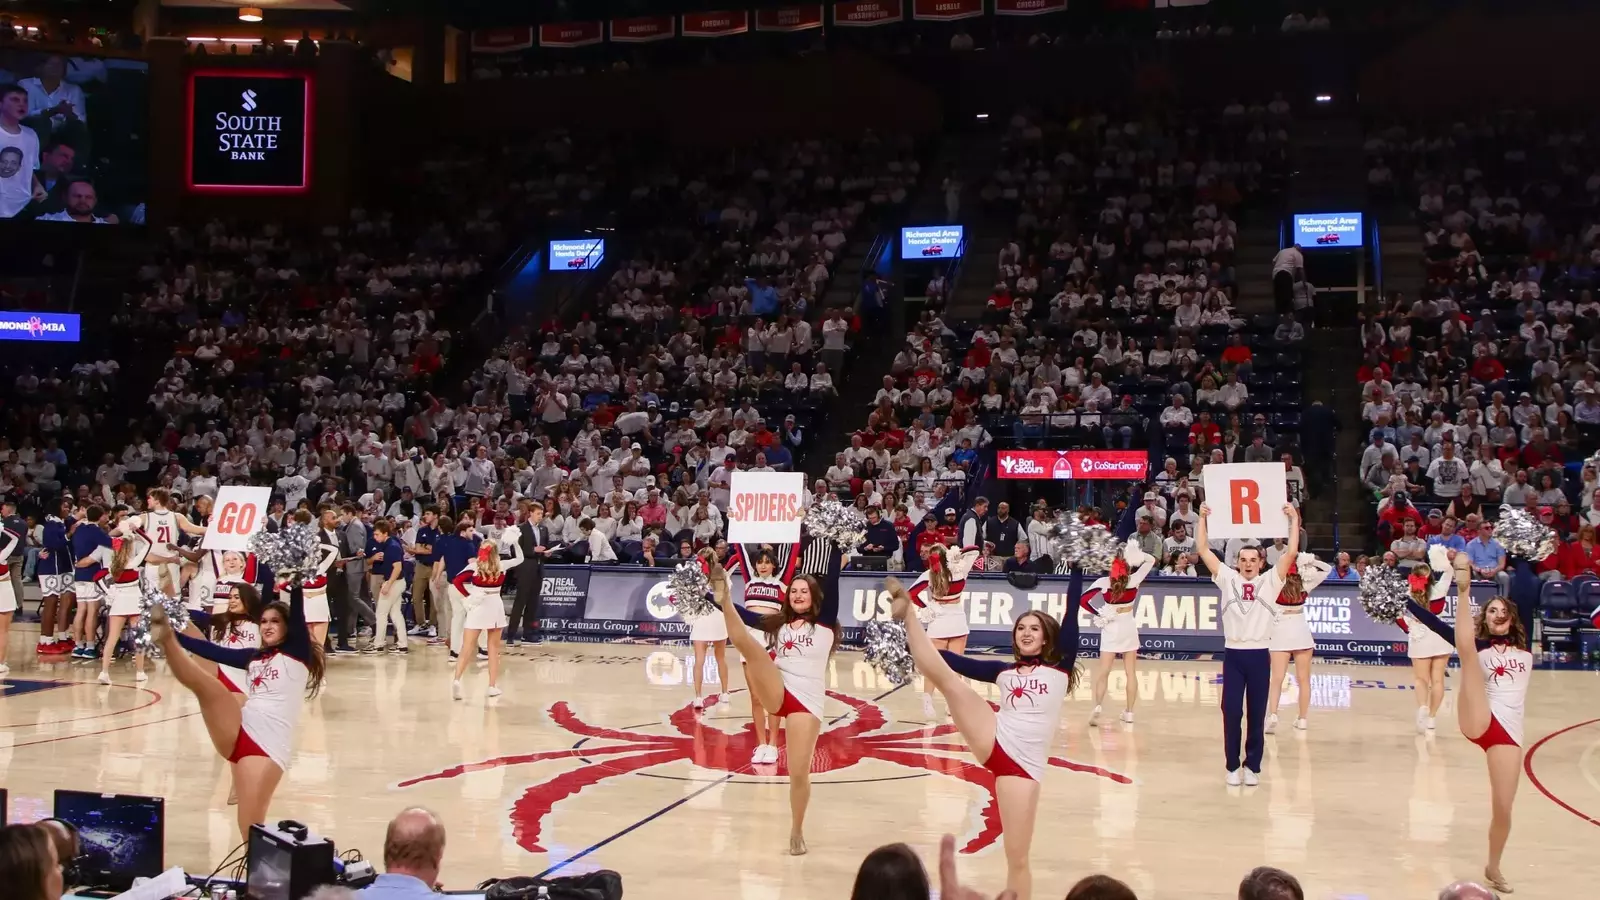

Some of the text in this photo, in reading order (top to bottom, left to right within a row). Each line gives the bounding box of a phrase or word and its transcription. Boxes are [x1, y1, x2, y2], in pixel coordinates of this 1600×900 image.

[216, 112, 282, 131] SOUTH
[219, 133, 278, 152] STATE
[231, 152, 266, 160] BANK
[1298, 218, 1338, 226] Richmond
[42, 323, 66, 332] MBA
[1018, 458, 1034, 467] Bon
[735, 493, 796, 522] SPIDERS
[1230, 479, 1262, 524] R
[218, 502, 256, 534] GO
[156, 526, 170, 543] 21
[1242, 584, 1255, 600] R
[1136, 595, 1218, 630] AME
[1303, 606, 1351, 622] WILD
[540, 619, 558, 628] The
[560, 620, 600, 630] Yeatman
[603, 620, 634, 634] Group
[1347, 641, 1386, 652] Group
